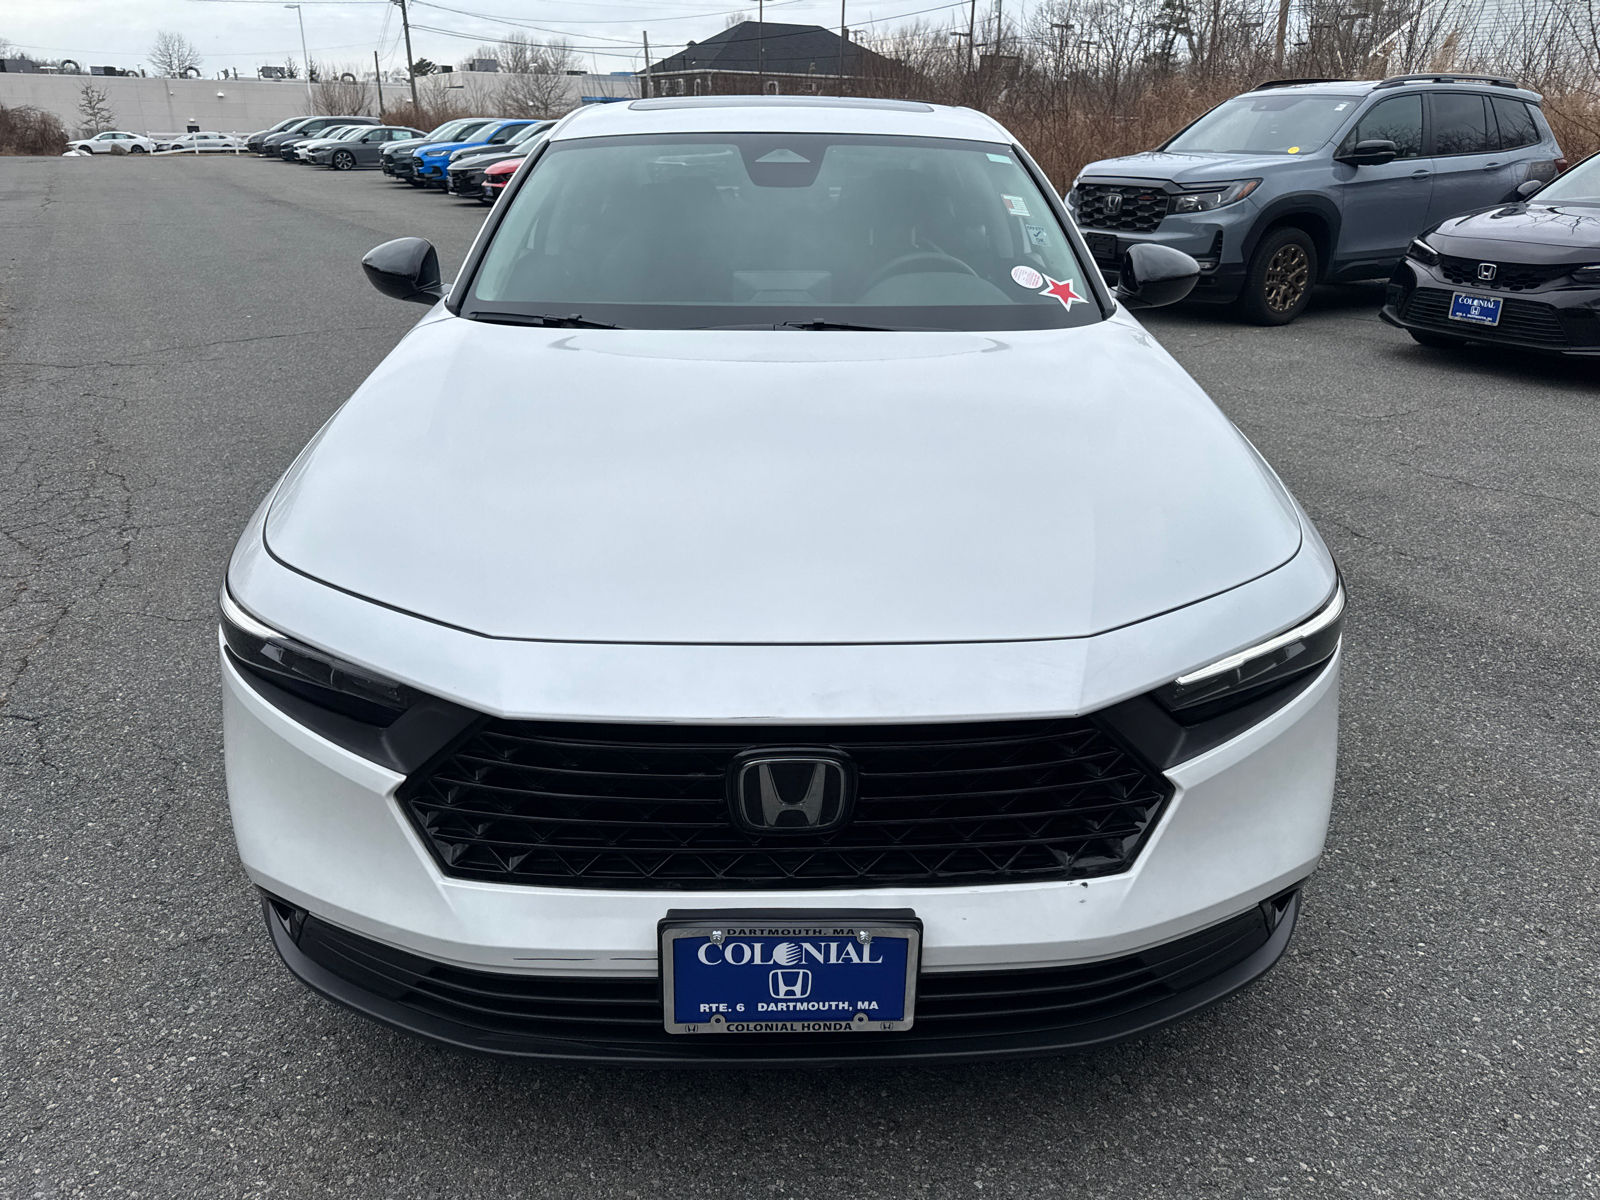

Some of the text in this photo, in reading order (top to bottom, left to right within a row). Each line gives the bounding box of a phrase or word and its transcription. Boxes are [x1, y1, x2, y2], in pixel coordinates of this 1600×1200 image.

[1459, 296, 1495, 308] COLONIAL
[727, 928, 827, 936] DARTMOUTH,
[697, 942, 883, 966] COLONIAL
[700, 1001, 879, 1012] RTE. 6 DARTMOUTH, MA
[726, 1022, 852, 1032] COLONIAL HONDA
